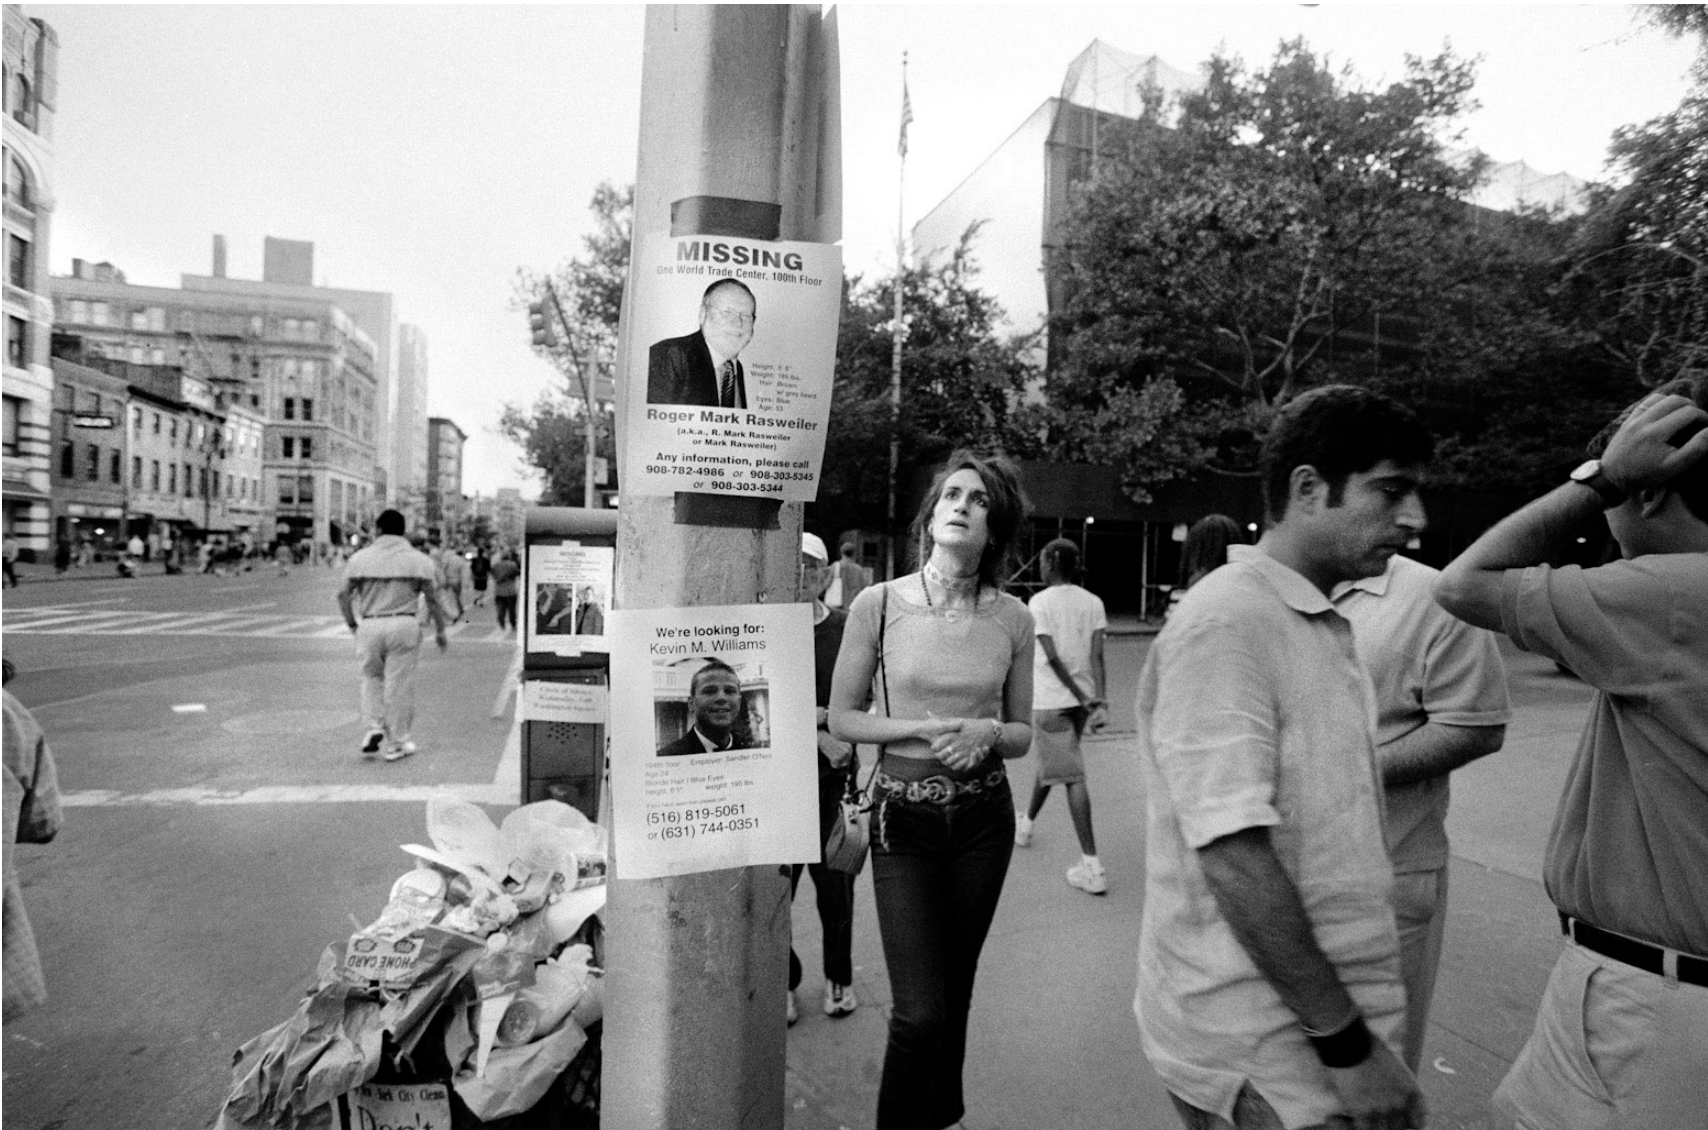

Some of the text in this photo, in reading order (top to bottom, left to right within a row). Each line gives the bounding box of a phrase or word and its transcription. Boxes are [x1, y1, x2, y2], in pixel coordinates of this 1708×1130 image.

[677, 242, 803, 271] MISSING
[657, 265, 822, 286] One World Trade Center, 100th Floor
[777, 380, 798, 388] Brown
[800, 392, 817, 400] beard
[647, 408, 818, 431] Roger Mark Rasweiler
[712, 429, 720, 437] R.
[724, 430, 746, 438] Mark
[749, 431, 791, 442] Rasweiler
[705, 438, 727, 447] Mark
[730, 440, 777, 451] Rasweiler)
[656, 452, 809, 469] Any information, please call
[646, 465, 814, 482] 908-782-4986 or 908-303-5345
[693, 481, 783, 492] or 908-303-5344
[656, 624, 765, 638] We're looking for:
[650, 639, 766, 656] Kevin M. Williams
[645, 770, 669, 779] Age 24
[645, 778, 668, 786] Blonde
[690, 776, 706, 784] Blue
[708, 774, 724, 783] Eyes
[731, 780, 742, 788] 195
[646, 804, 746, 826] (516) 819-5061
[648, 818, 760, 840] or (631) 744-0351
[348, 954, 378, 968] CARD
[399, 1090, 414, 1106] City
